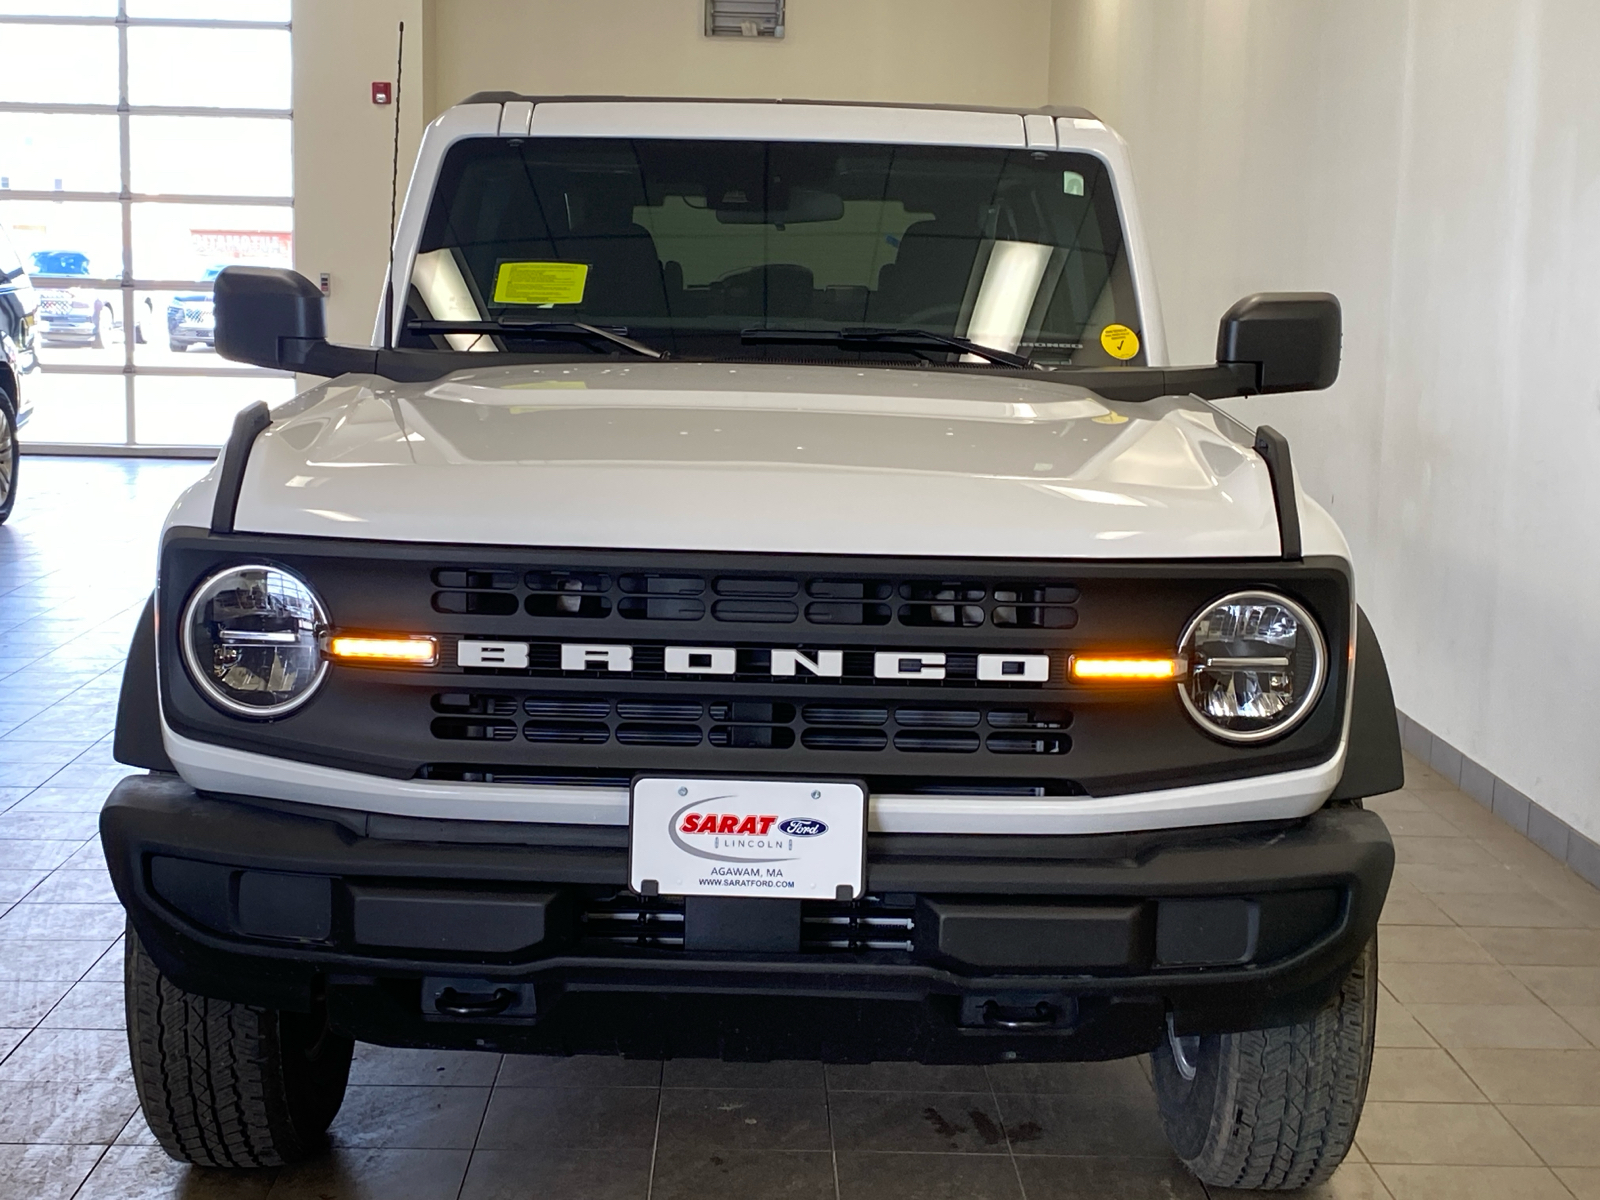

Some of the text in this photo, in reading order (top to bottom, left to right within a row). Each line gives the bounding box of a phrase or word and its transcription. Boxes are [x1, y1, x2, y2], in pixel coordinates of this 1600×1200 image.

[457, 639, 1050, 682] BRONCO
[680, 813, 820, 836] SARAT Ford
[724, 840, 783, 849] LINCOLN
[711, 867, 783, 878] AGAWAM, MA
[699, 878, 795, 888] WWW.SARATFORD.COM
